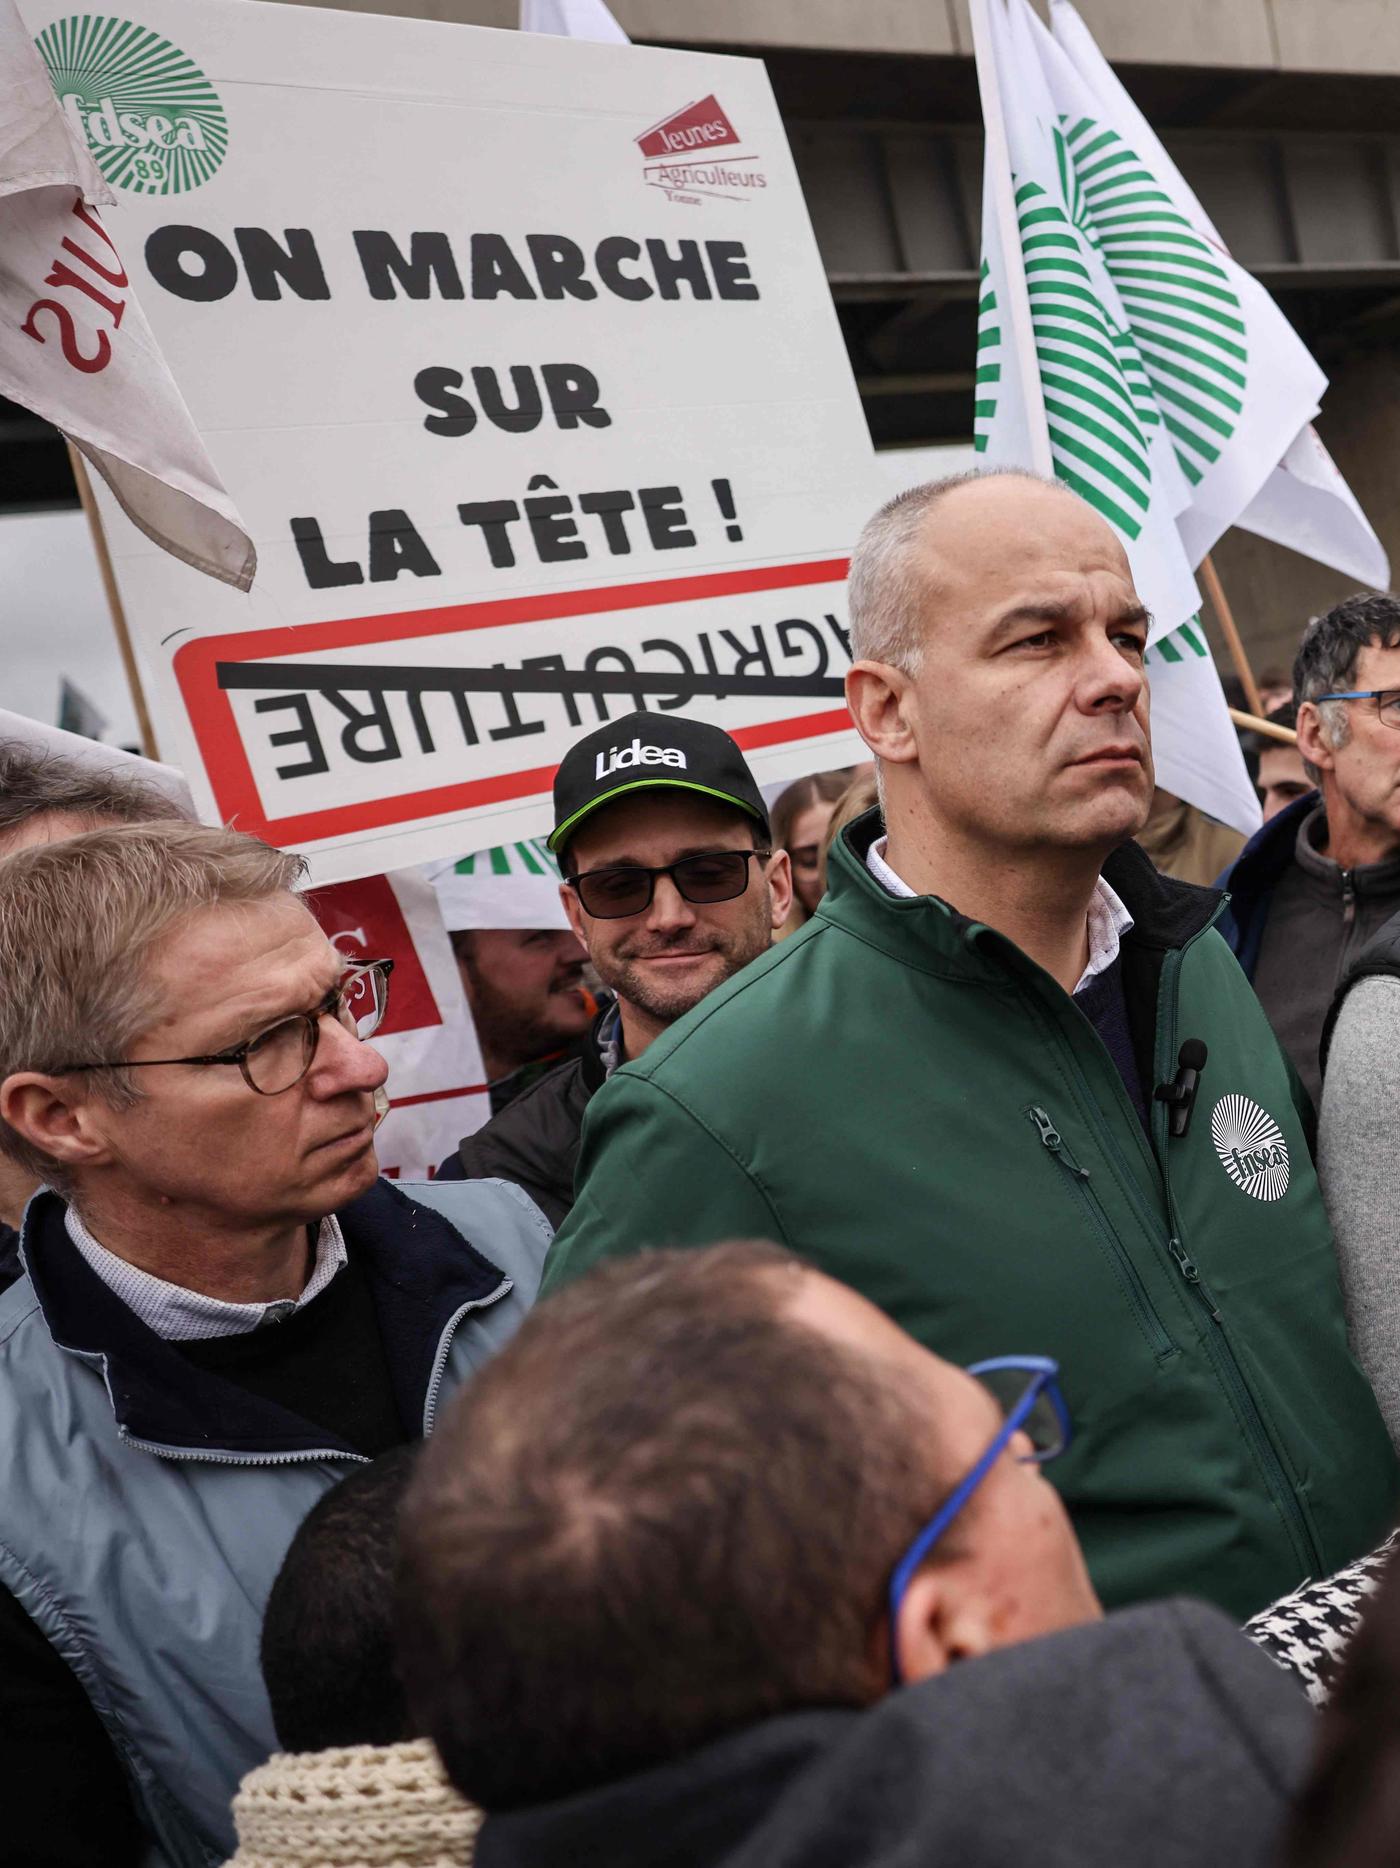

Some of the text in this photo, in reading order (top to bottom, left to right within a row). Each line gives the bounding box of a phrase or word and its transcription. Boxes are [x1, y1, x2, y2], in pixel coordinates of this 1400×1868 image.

[62, 93, 208, 151] fdsea
[659, 119, 728, 153] Jeunes
[134, 158, 166, 180] 89
[660, 164, 767, 188] Agriculteurs
[144, 224, 761, 302] ON MARCHE
[414, 363, 612, 437] SUR
[290, 474, 744, 589] LA TÊTE !
[595, 738, 688, 781] Lidea
[1231, 1144, 1285, 1180] fnsea
